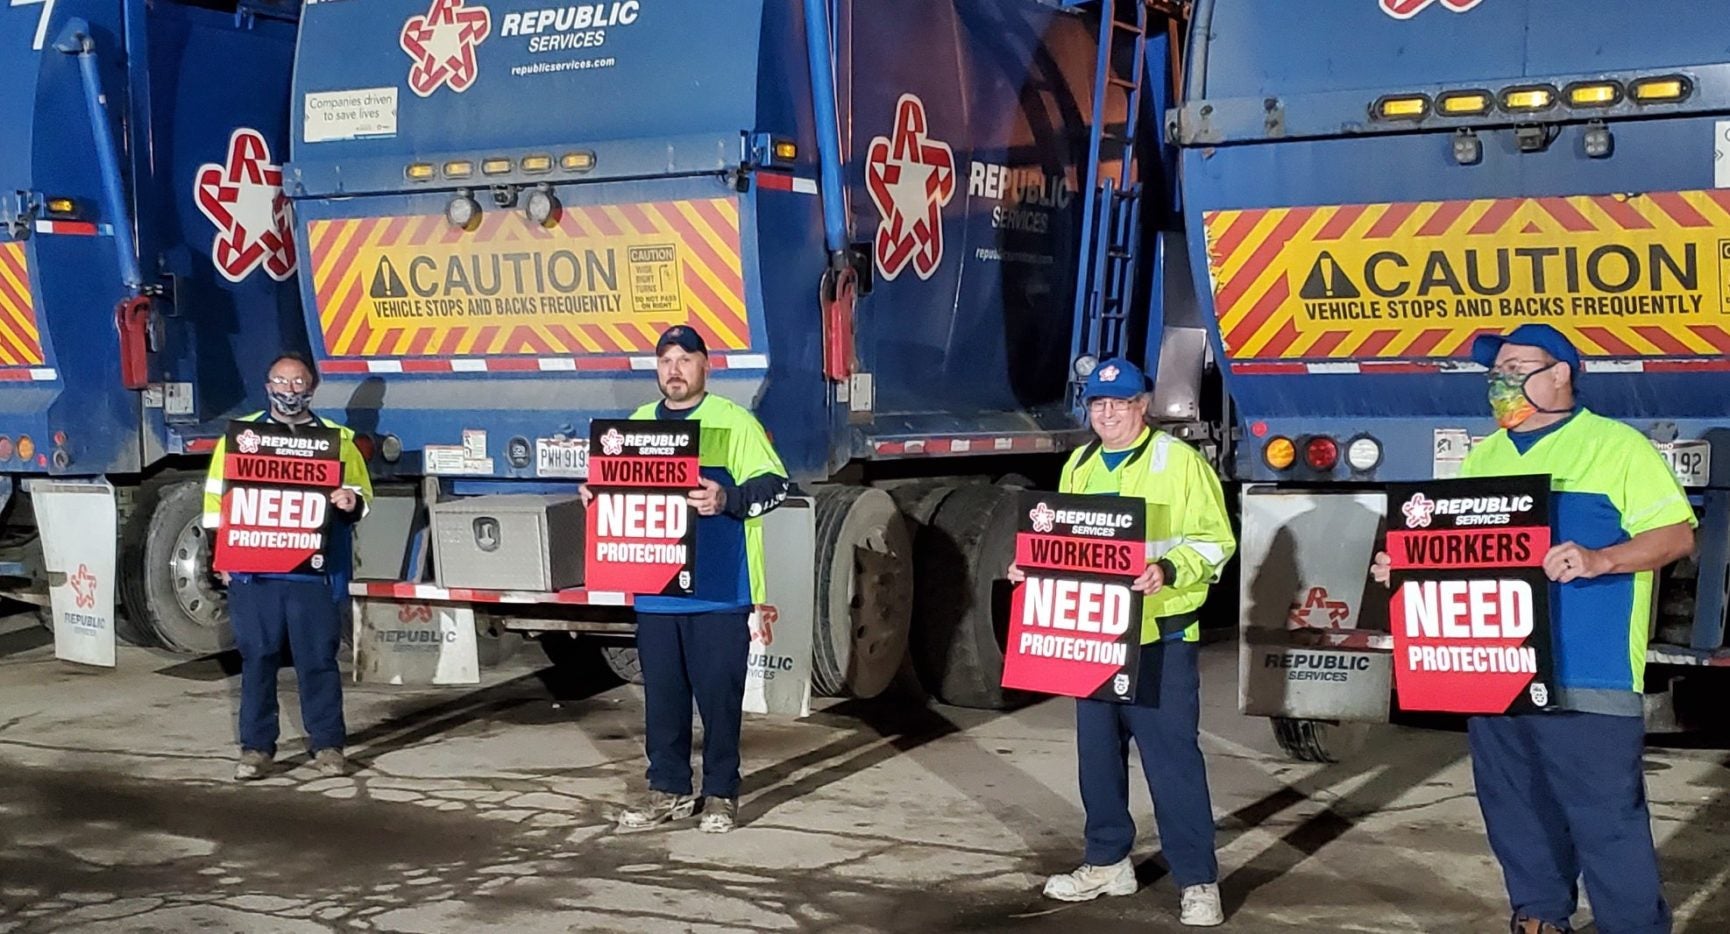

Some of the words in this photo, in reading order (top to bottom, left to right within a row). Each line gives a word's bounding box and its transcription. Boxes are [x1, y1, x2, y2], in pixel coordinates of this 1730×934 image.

[501, 1, 639, 36] REPUBLIC
[529, 31, 605, 52] SERVICES
[511, 58, 615, 76] republicservices.com
[309, 95, 361, 109] Companies
[363, 93, 393, 106] driven
[324, 112, 334, 121] to
[336, 110, 357, 120] save
[359, 108, 380, 119] lives
[969, 161, 1069, 208] REPUBLIC
[992, 206, 1048, 233] SERVICES
[631, 249, 673, 261] CAUTION
[409, 247, 619, 299] CAUTION
[1362, 242, 1699, 299] CAUTION
[373, 299, 423, 319] VEHICLE
[425, 299, 464, 317] STOPS
[467, 297, 490, 316] AND
[495, 296, 537, 316] BACKS
[540, 294, 623, 313] FREQUENTLY
[1304, 300, 1382, 321] VEHICLE
[1387, 299, 1448, 319] STOPS
[1454, 298, 1493, 318] AND
[1499, 297, 1565, 317] BACKS
[1571, 294, 1703, 316] FREQUENTLY
[260, 435, 330, 451] REPUBLIC
[624, 434, 689, 447] REPUBLIC
[638, 447, 675, 456] SERVICES
[236, 457, 327, 482] WORKERS
[601, 460, 687, 483] WORKERS
[230, 487, 327, 529] NEED
[597, 494, 688, 539] NEED
[1435, 496, 1534, 515] REPUBLIC
[1055, 510, 1133, 528] REPUBLIC
[1455, 513, 1511, 526] SERVICES
[228, 530, 322, 549] PROTECTION
[1072, 525, 1115, 537] SERVICES
[597, 542, 687, 565] PROTECTION
[1030, 538, 1132, 571] WORKERS
[1404, 532, 1531, 565] WORKERS
[1022, 576, 1131, 635] NEED
[1403, 579, 1534, 639] NEED
[64, 612, 105, 628] REPUBLIC
[376, 630, 457, 643] REPUBLIC
[1019, 632, 1127, 666] PROTECTION
[1408, 645, 1537, 673] PROTECTION
[1264, 654, 1370, 671] REPUBLIC
[1288, 670, 1348, 682] SERVICES
